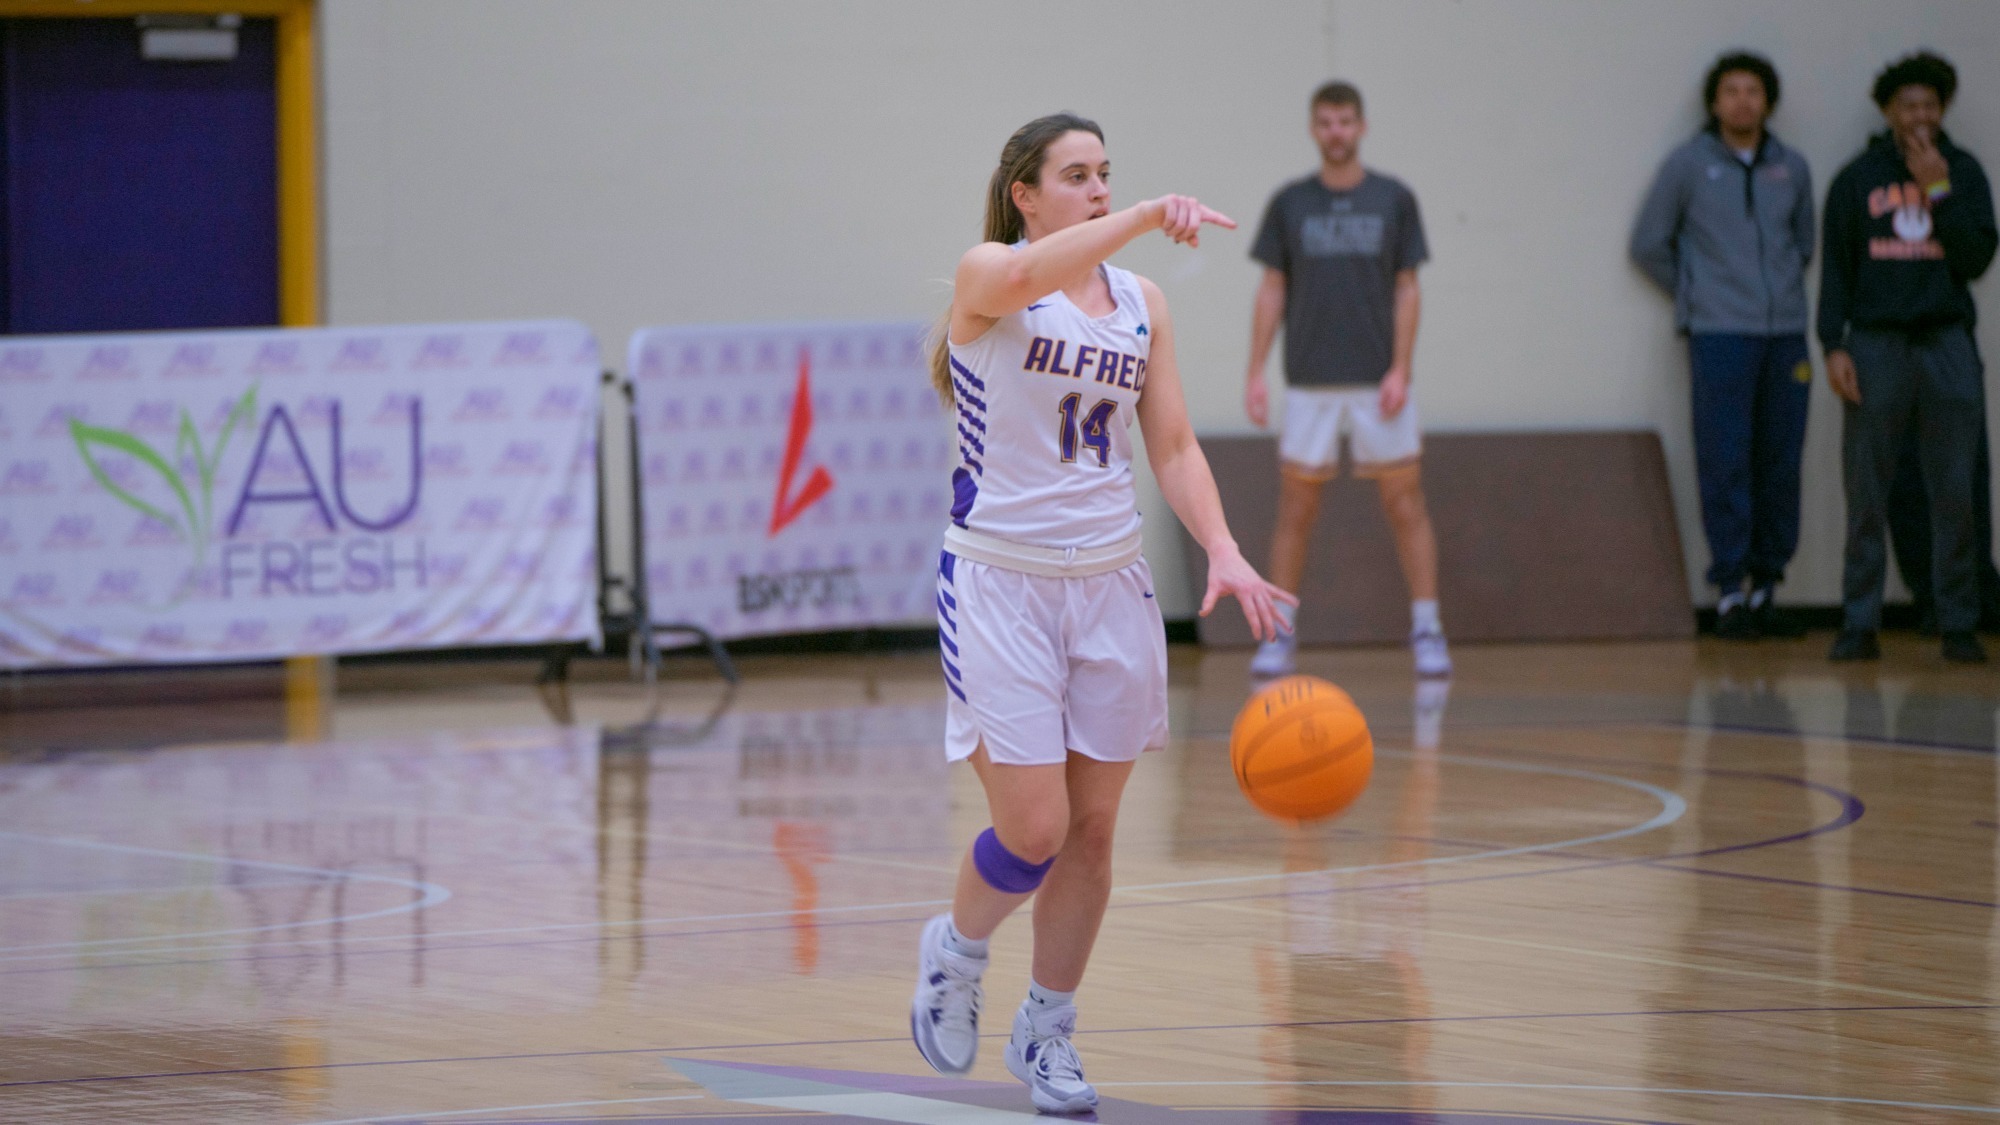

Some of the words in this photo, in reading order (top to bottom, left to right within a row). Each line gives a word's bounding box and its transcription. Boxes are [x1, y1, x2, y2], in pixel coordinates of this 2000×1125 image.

[227, 396, 425, 537] AU
[1058, 391, 1118, 468] 14
[221, 537, 428, 598] FRESH
